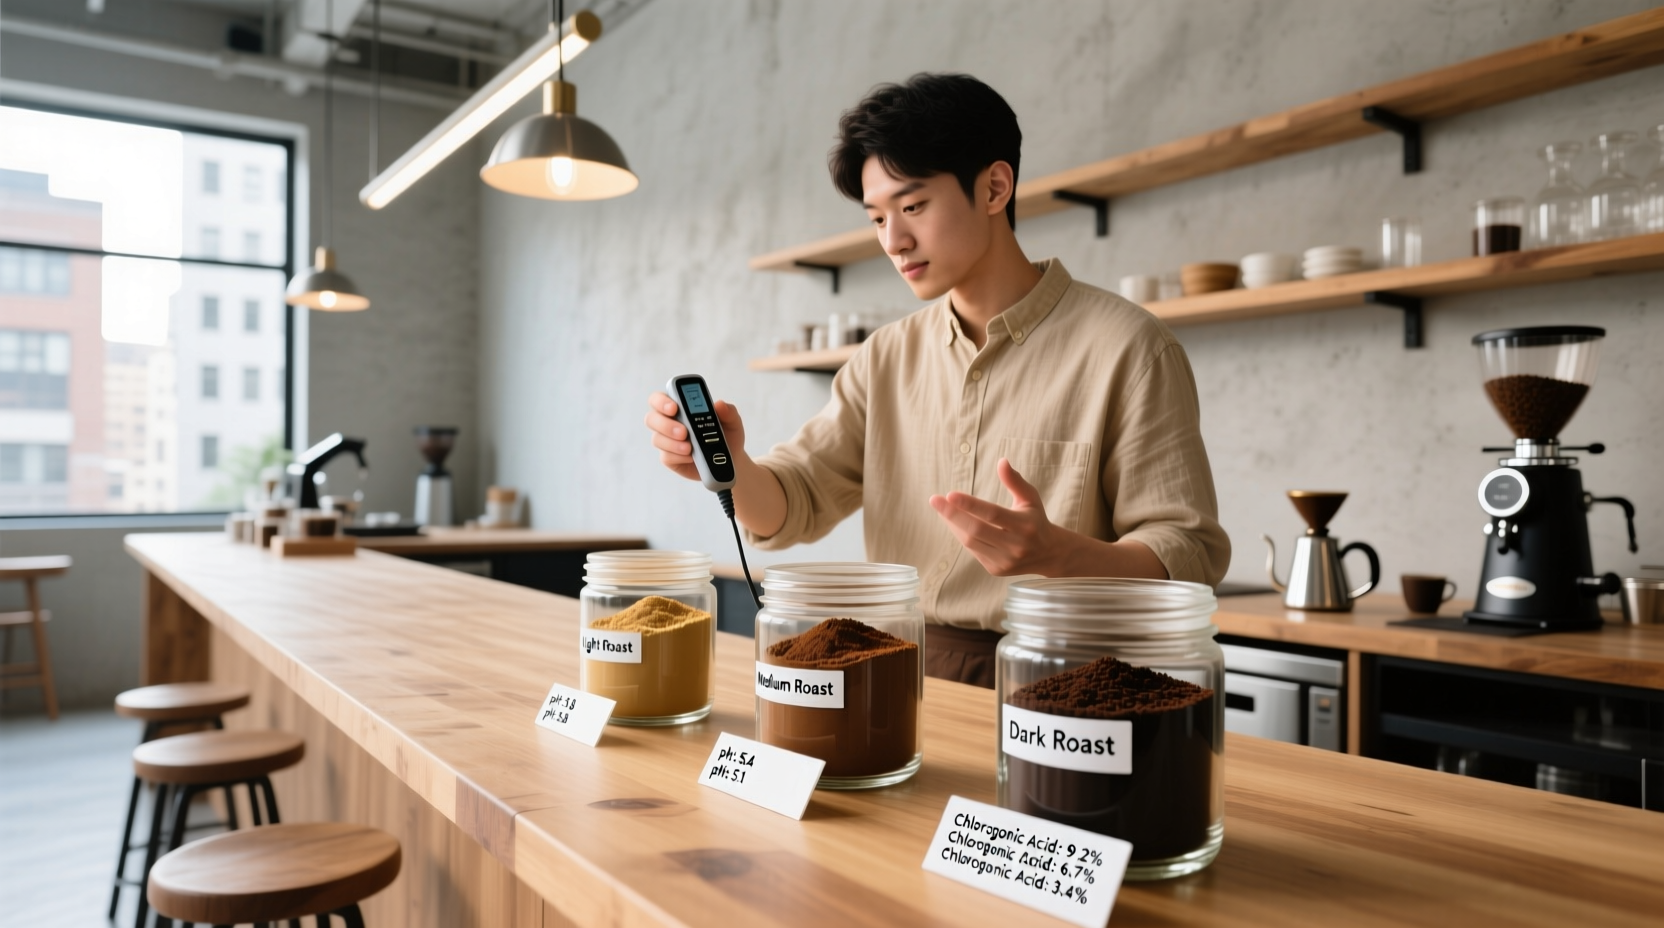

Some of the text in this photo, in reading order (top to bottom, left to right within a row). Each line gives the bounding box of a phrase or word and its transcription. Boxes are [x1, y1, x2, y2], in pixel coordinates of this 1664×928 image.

[794, 679, 834, 696] Roast
[1009, 719, 1115, 756] Dark Roast
[1026, 834, 1063, 855] Acid:
[1060, 862, 1095, 885] 6.7%
[1014, 869, 1049, 892] Acid:
[1051, 879, 1088, 905] 3.4%
